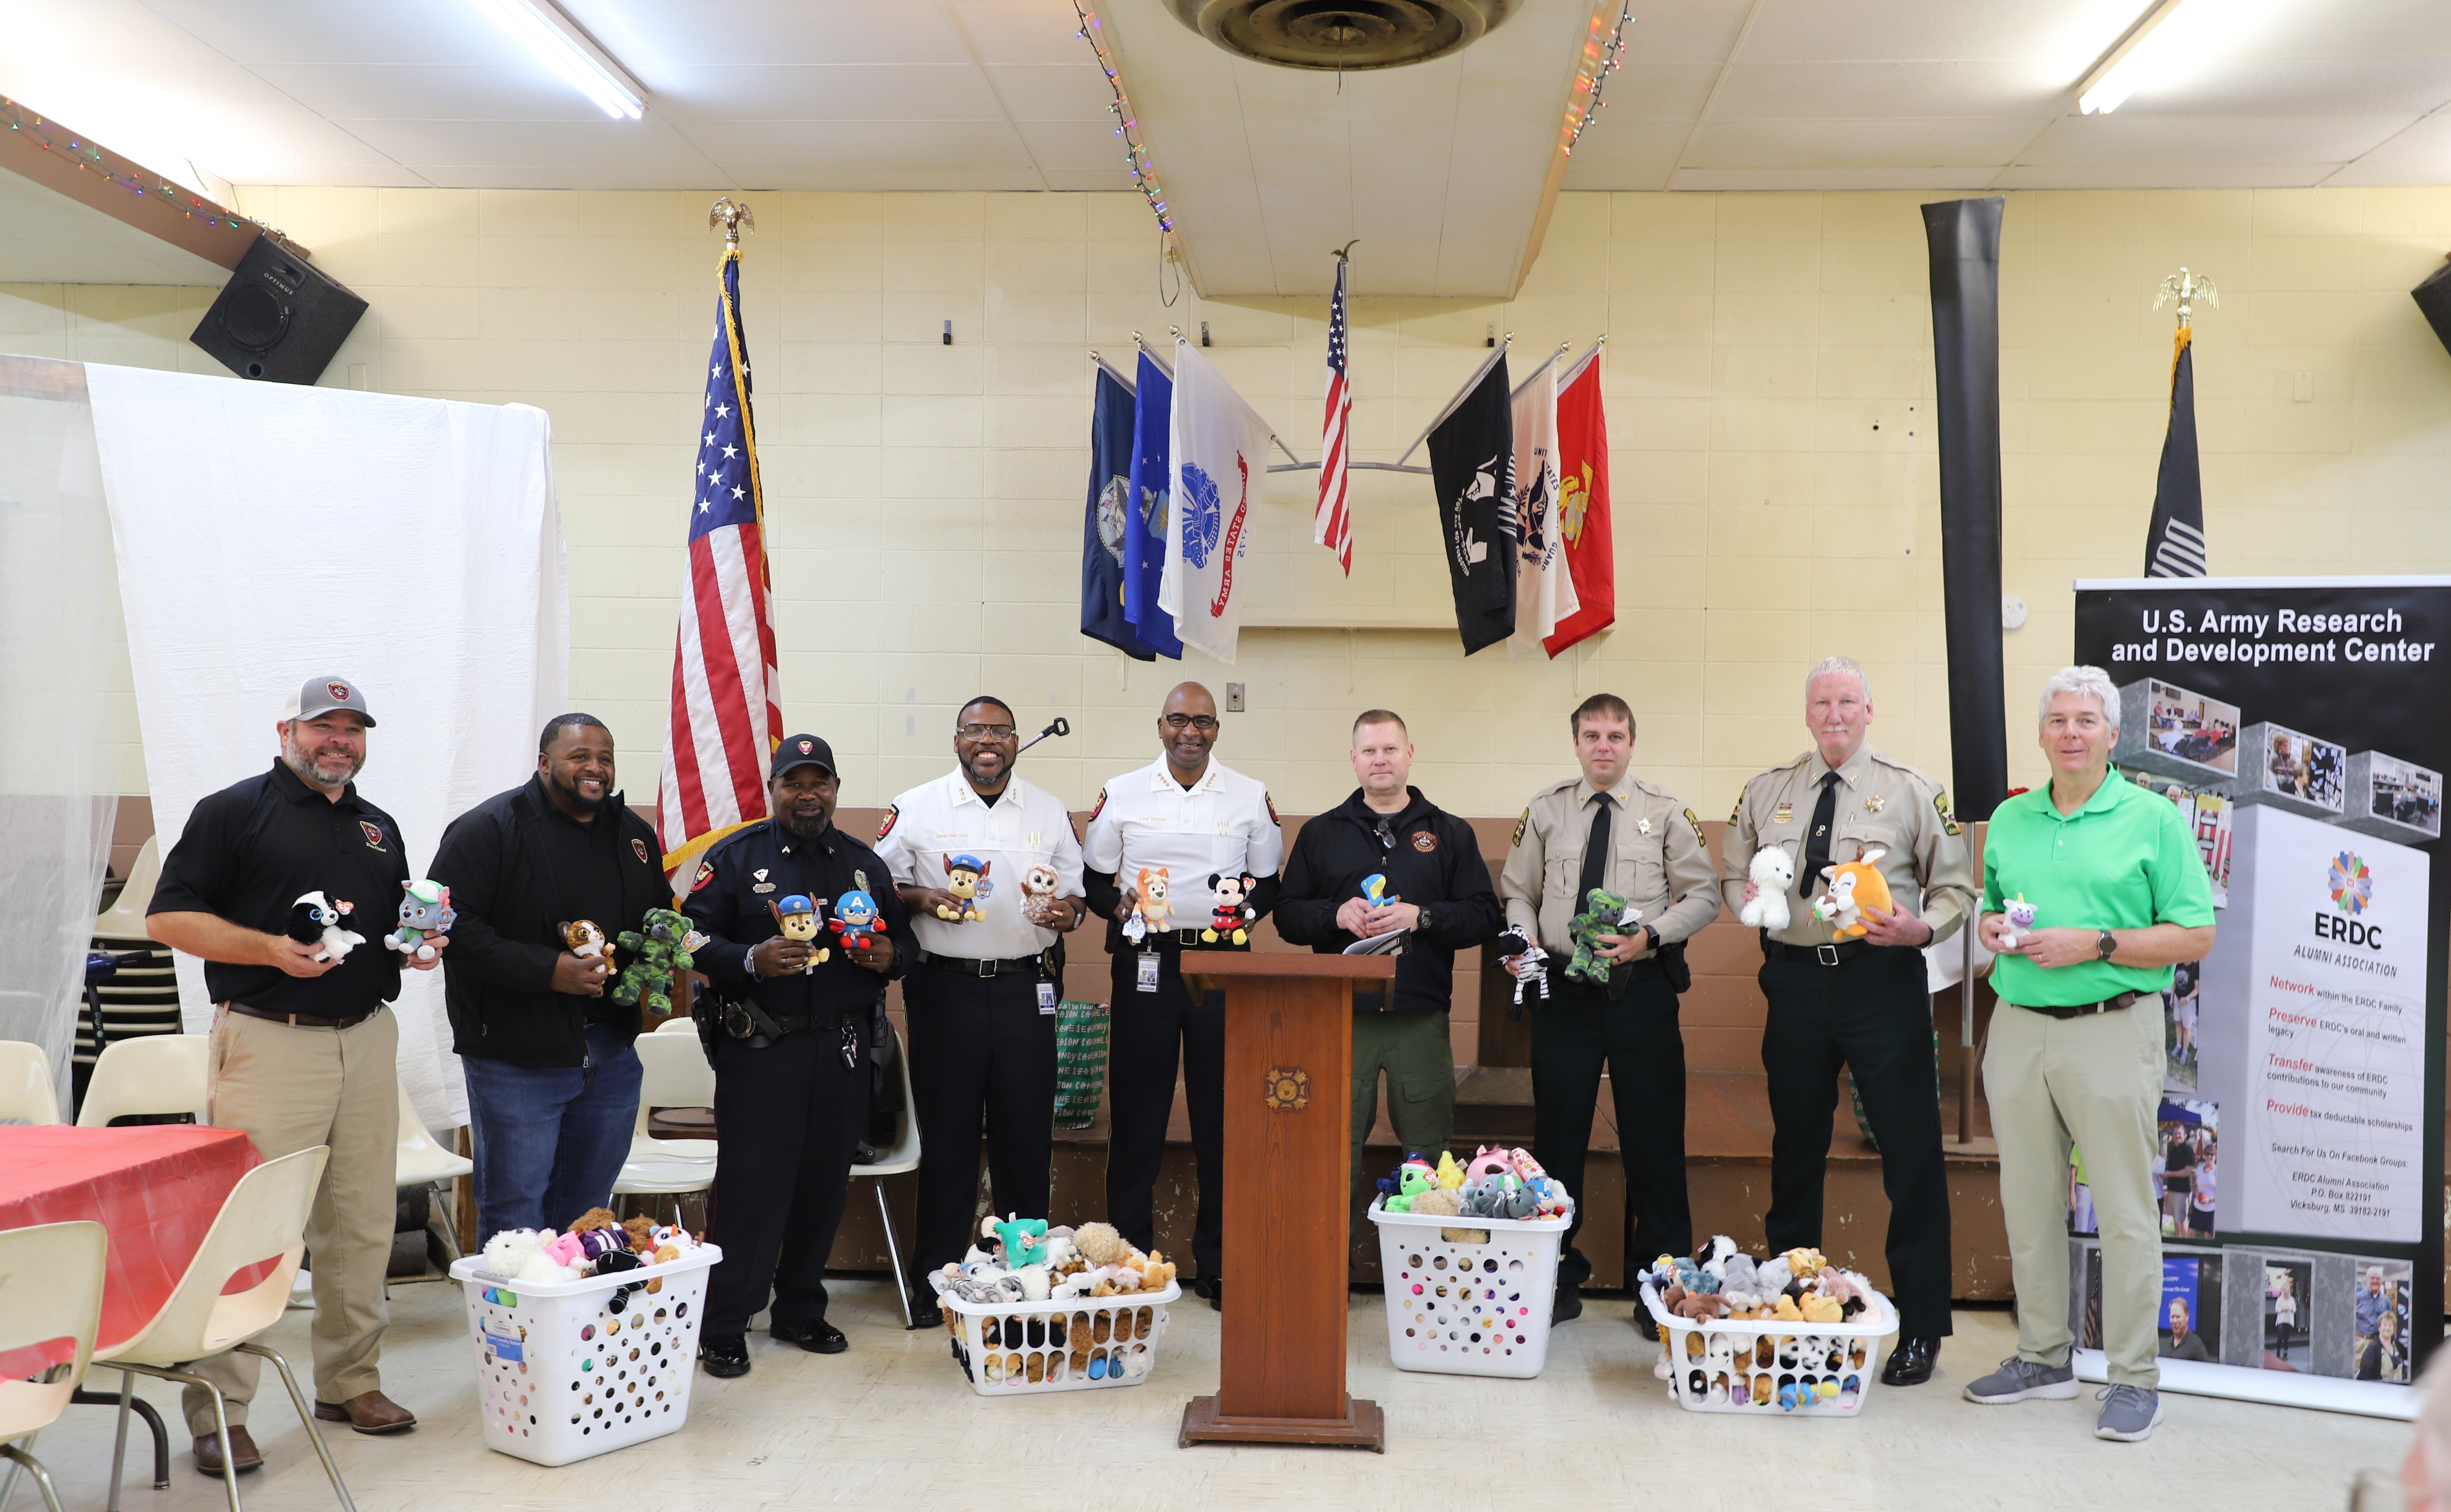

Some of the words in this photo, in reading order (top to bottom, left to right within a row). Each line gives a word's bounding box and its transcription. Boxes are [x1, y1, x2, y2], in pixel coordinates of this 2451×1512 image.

[264, 273, 293, 294] OPTIMUS
[1546, 461, 1559, 491] TATES
[1455, 545, 1470, 577] FORGOTTEN
[1541, 541, 1558, 571] GUARD
[2142, 609, 2192, 634] U.S.
[2199, 609, 2269, 639] Army
[2278, 607, 2402, 633] Research
[2112, 637, 2157, 662] and
[2166, 637, 2336, 667] Development
[2344, 637, 2435, 662] Center
[337, 903, 350, 912] ty
[850, 896, 864, 908] A
[1122, 927, 1145, 937] BLUEY
[2315, 911, 2382, 950] ERDC
[2293, 944, 2332, 964] ALUMNI
[2334, 954, 2398, 978] ASSOCIATION
[2269, 976, 2315, 996] Network
[2316, 989, 2339, 1001] within
[2341, 994, 2353, 1005] the
[2356, 996, 2377, 1009] ERDC
[2379, 1001, 2402, 1015] Family
[2268, 1024, 2294, 1039] legacy
[2269, 1007, 2317, 1028] Preserve
[2320, 1020, 2348, 1034] ERDC's
[2350, 1027, 2365, 1038] oral
[2366, 1030, 2380, 1040] and
[2382, 1032, 2406, 1045] written
[1056, 1038, 1079, 1046] EASON
[1057, 1052, 1077, 1064] ANDY
[2268, 1053, 2314, 1071] Transfer
[2315, 1066, 2355, 1080] awareness
[2357, 1071, 2366, 1080] of
[2367, 1073, 2388, 1085] ERDC
[2267, 1071, 2319, 1087] contributions
[2322, 1079, 2329, 1089] to
[2331, 1083, 2343, 1091] our
[2346, 1084, 2387, 1100] community
[2266, 1099, 2309, 1117] Provide
[2310, 1110, 2322, 1120] tax
[2324, 1111, 2365, 1126] deductable
[2367, 1118, 2413, 1133] scholarships
[2271, 1143, 2299, 1156] Search
[2301, 1147, 2314, 1157] For
[2317, 1148, 2327, 1159] Us
[2329, 1150, 2340, 1160] On
[2342, 1151, 2378, 1165] Facebook
[2292, 1171, 2315, 1183] ERDC
[2317, 1175, 2344, 1187] Alumni
[2346, 1179, 2389, 1191] Association
[2311, 1188, 2326, 1198] P.O.
[2329, 1190, 2343, 1200] Box
[2290, 1199, 2331, 1214] Vicksburg,
[2333, 1204, 2345, 1213] MS
